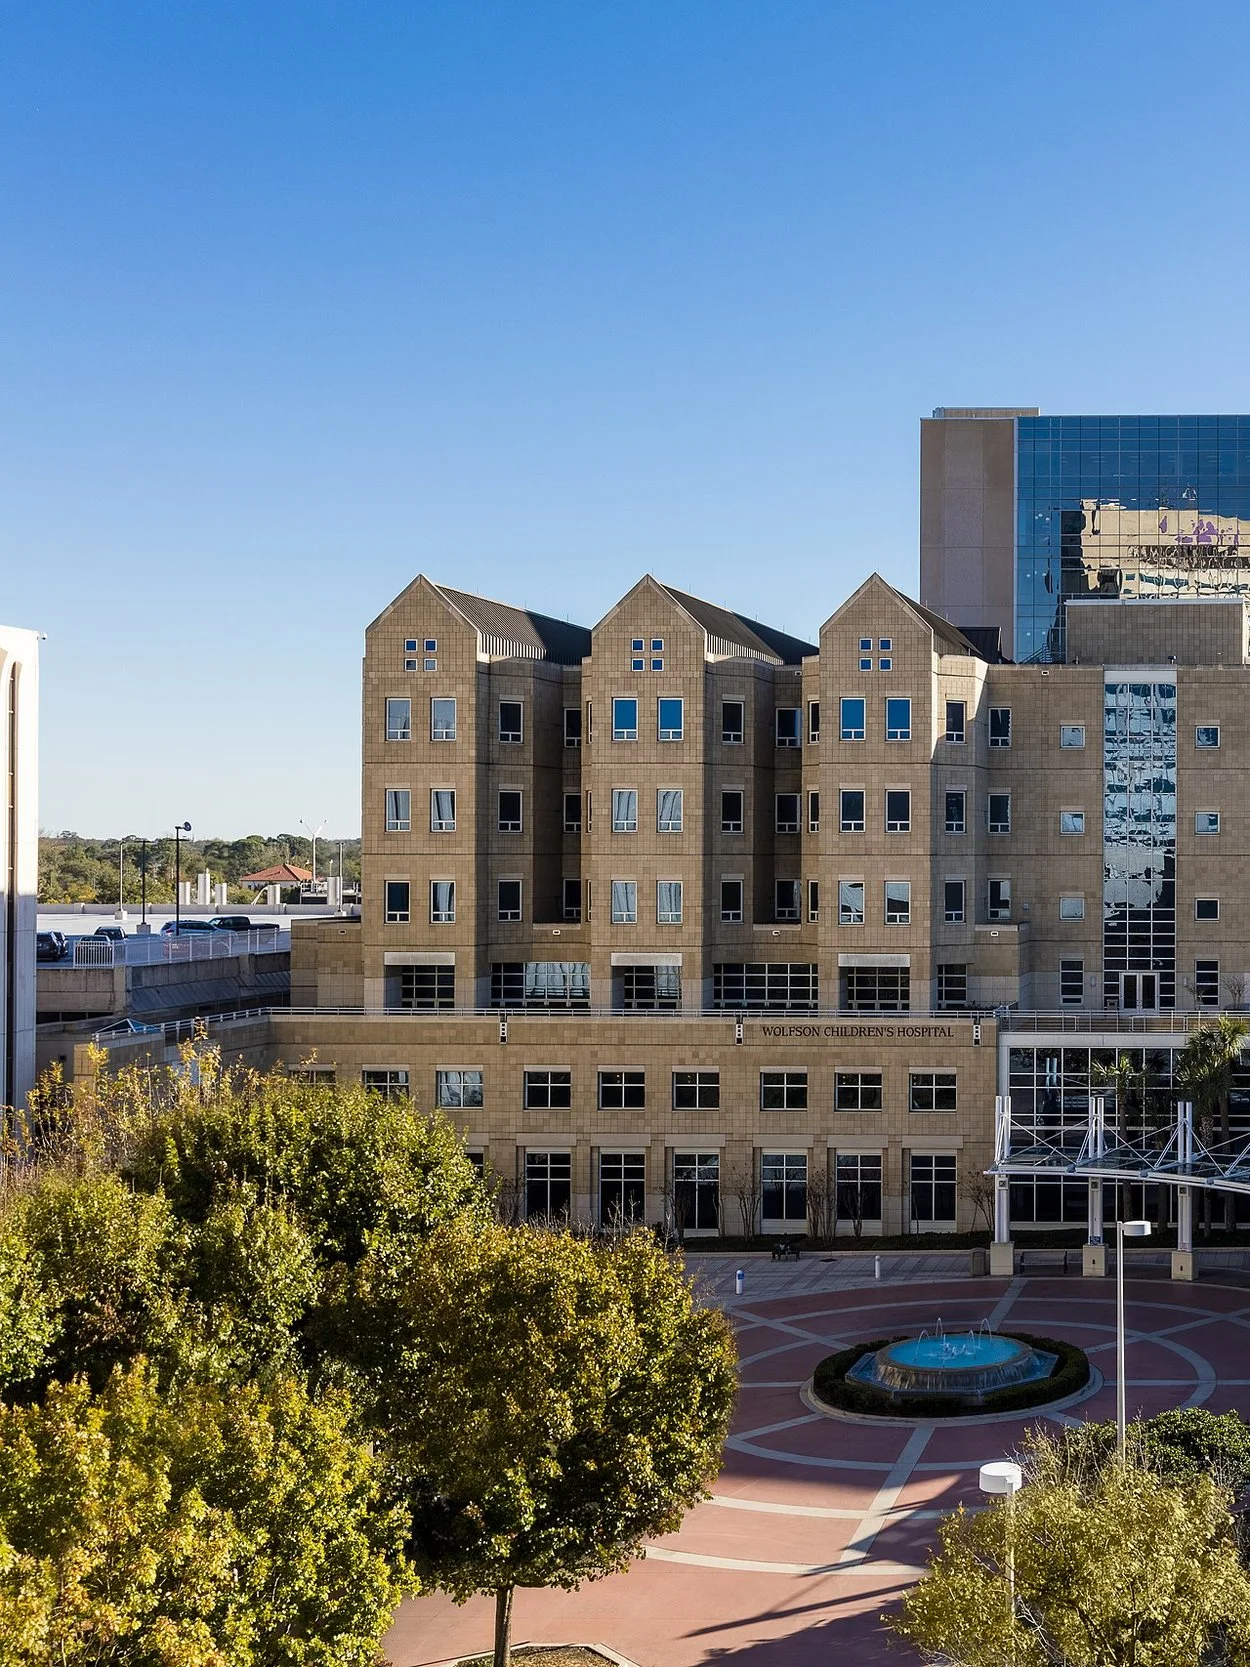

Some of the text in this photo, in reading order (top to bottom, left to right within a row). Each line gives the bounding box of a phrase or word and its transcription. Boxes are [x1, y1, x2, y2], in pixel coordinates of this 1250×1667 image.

[762, 1026, 954, 1037] WOLFSON CHILDREN'S HOSPITAL
